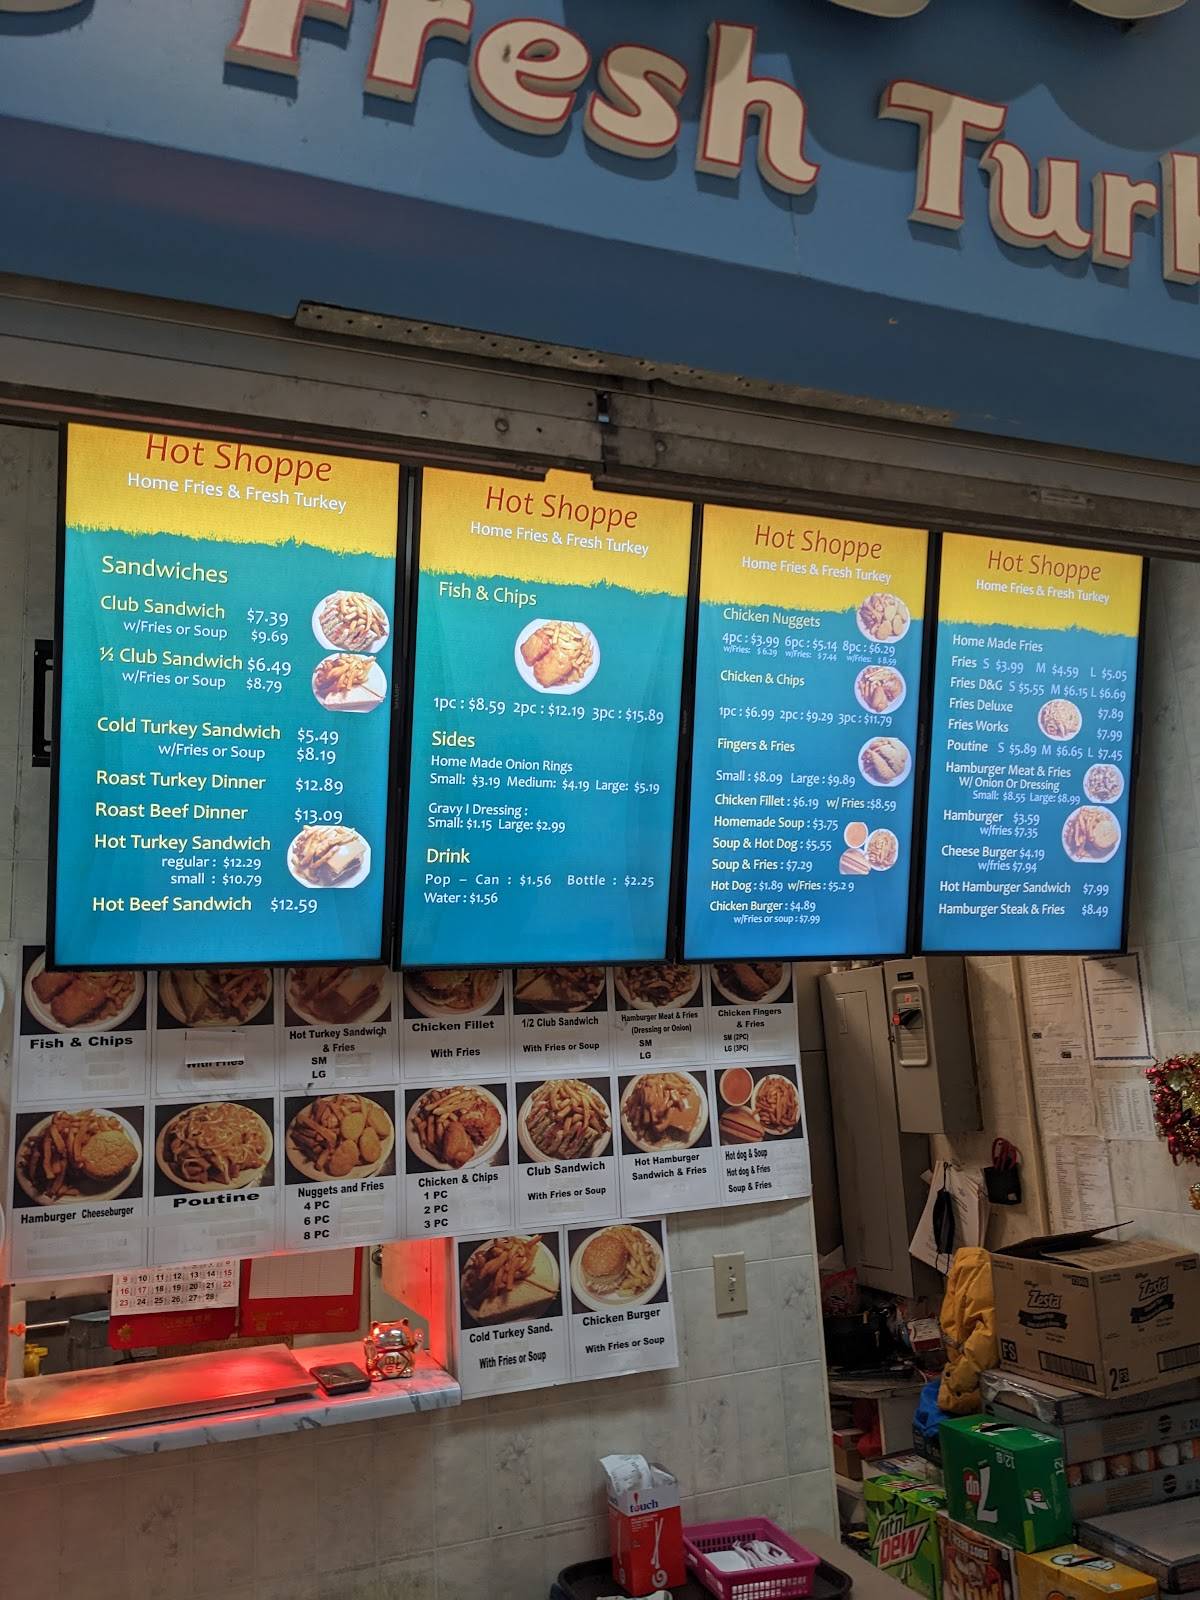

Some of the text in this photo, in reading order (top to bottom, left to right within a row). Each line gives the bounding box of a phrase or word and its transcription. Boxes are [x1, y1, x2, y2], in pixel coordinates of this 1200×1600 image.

[146, 435, 331, 486] Hot Shoppe
[128, 472, 346, 514] Home Fries & Fresh Turkey
[486, 486, 637, 532] Hot Shoppe
[472, 522, 648, 557] Home Fries & Fresh Turkey
[756, 524, 881, 563] Hot Shoppe
[102, 556, 227, 583] Sandwiches
[742, 557, 891, 584] Home Fries & Fresh Turkey
[988, 550, 1101, 584] Hot Shoppe
[440, 582, 536, 608] Fish & Chips
[976, 580, 1109, 604] Home Fries & Fresh Turkey
[101, 595, 288, 626] Club Sandwich $7.39
[724, 608, 820, 629] Chicken Nuggets
[124, 620, 288, 645] w/Fries or Soup $9.69
[953, 634, 1043, 652] Home Made Fries
[120, 648, 157, 664] Club
[163, 651, 242, 670] Sandwich
[248, 657, 291, 676] $6.49
[721, 670, 804, 688] Chicken & Chips
[950, 698, 1124, 722] Fries Deluxe $7.89
[98, 717, 338, 745] Cold Turkey Sandwich $5.49
[432, 731, 475, 747] Sides
[948, 719, 1122, 742] Fries Works $7.99
[718, 738, 795, 752] Fingers & Fries
[432, 755, 572, 775] Home Made Onion Rings
[97, 770, 343, 794] Roast Turkey Dinner $12.89
[430, 773, 660, 794] Small: $3.19 Medium: $4.19 Large: $5.19
[96, 802, 342, 824] Roast Beef Dinner $13.09
[944, 810, 1040, 826] Hamburger $3.59
[428, 817, 565, 833] Small: $1.15 Large: $2.99
[95, 834, 270, 853] Hot Turkey Sandwich
[942, 845, 1044, 860] Cheese Burger $4.19
[427, 848, 470, 863] Drink
[940, 881, 1109, 896] Hot Hamburger Sandwich $7.99
[93, 896, 317, 913] Hot Beef Sandwich $12.59
[939, 903, 1108, 917] Hamburger Steak & Fries $8.49
[290, 1026, 386, 1039] Hot Turkey Sandwich
[412, 1020, 495, 1031] Chicken Fillet
[30, 1036, 132, 1049] Fish & Chips
[312, 1070, 326, 1078] LG
[527, 1161, 605, 1176] Club Sandwich
[418, 1172, 498, 1187] Chicken & Chips
[173, 1192, 260, 1208] Poutine
[298, 1182, 384, 1198] Nuggets and Fries
[1138, 1276, 1170, 1301] Zesta
[1028, 1290, 1062, 1309] Zesta
[583, 1310, 660, 1326] Chicken Burger
[470, 1323, 552, 1343] Cold Turkey Sand.
